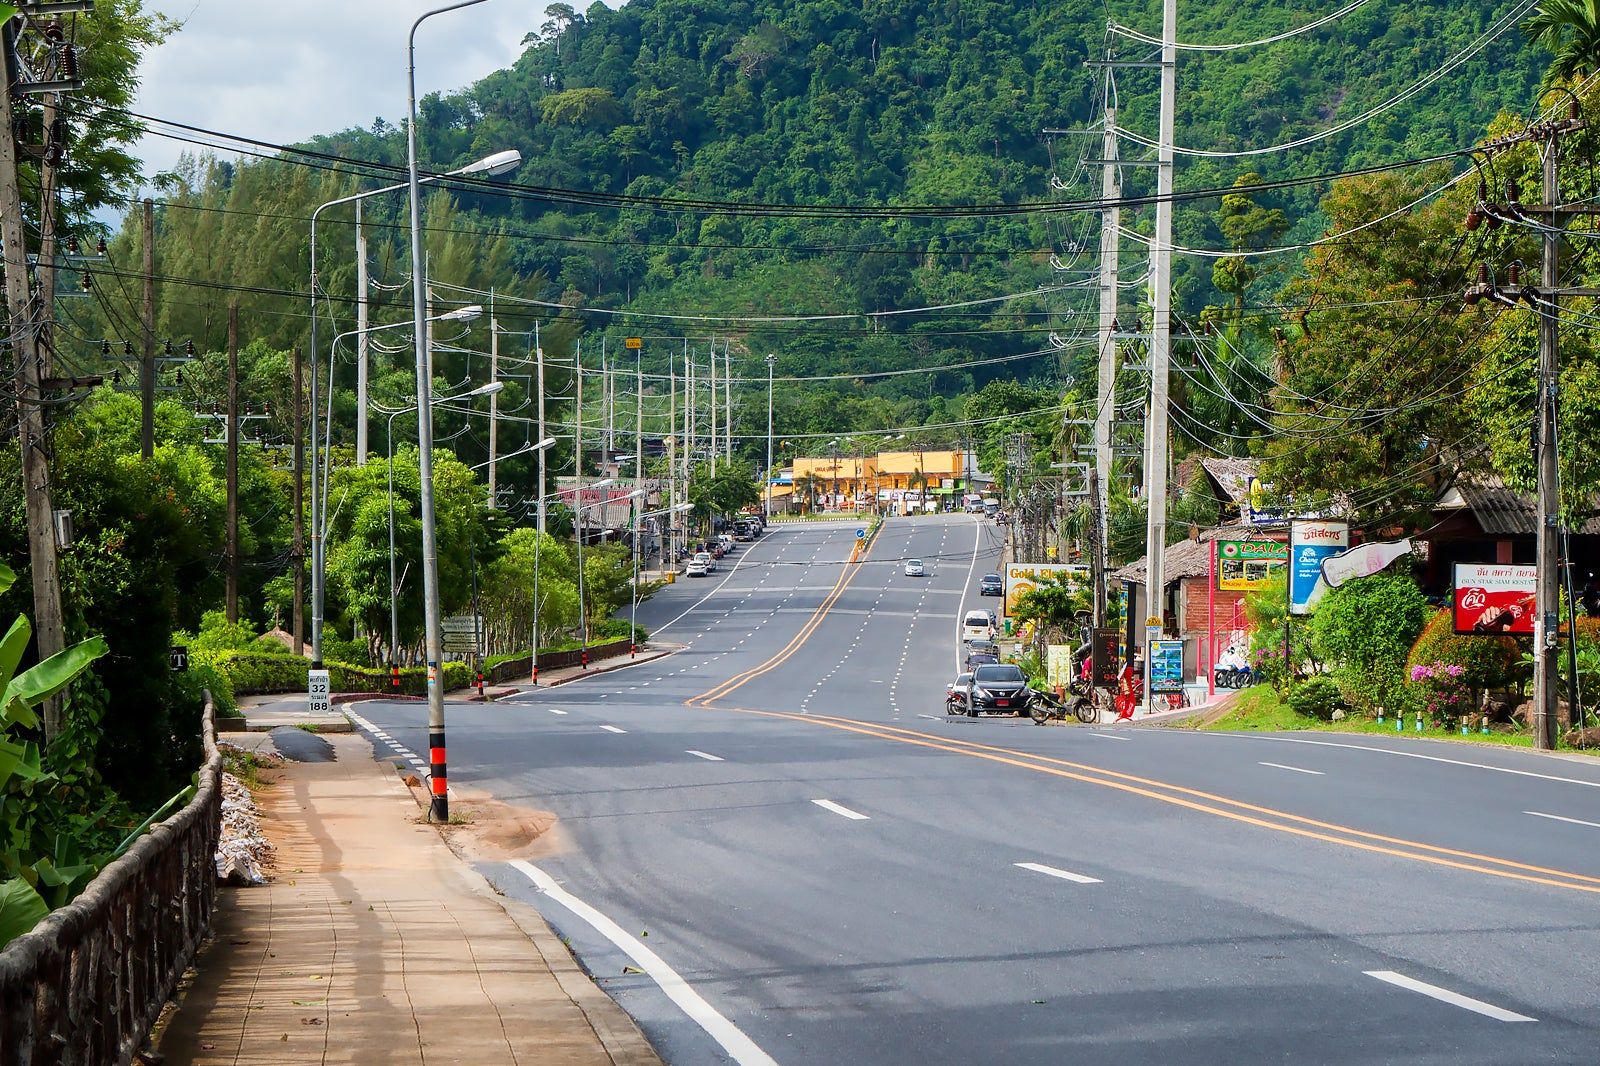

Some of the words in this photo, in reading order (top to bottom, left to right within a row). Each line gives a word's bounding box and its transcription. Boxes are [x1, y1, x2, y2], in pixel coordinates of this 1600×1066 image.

[1010, 568, 1034, 579] Gold
[312, 684, 326, 693] 32
[310, 702, 328, 711] 188
